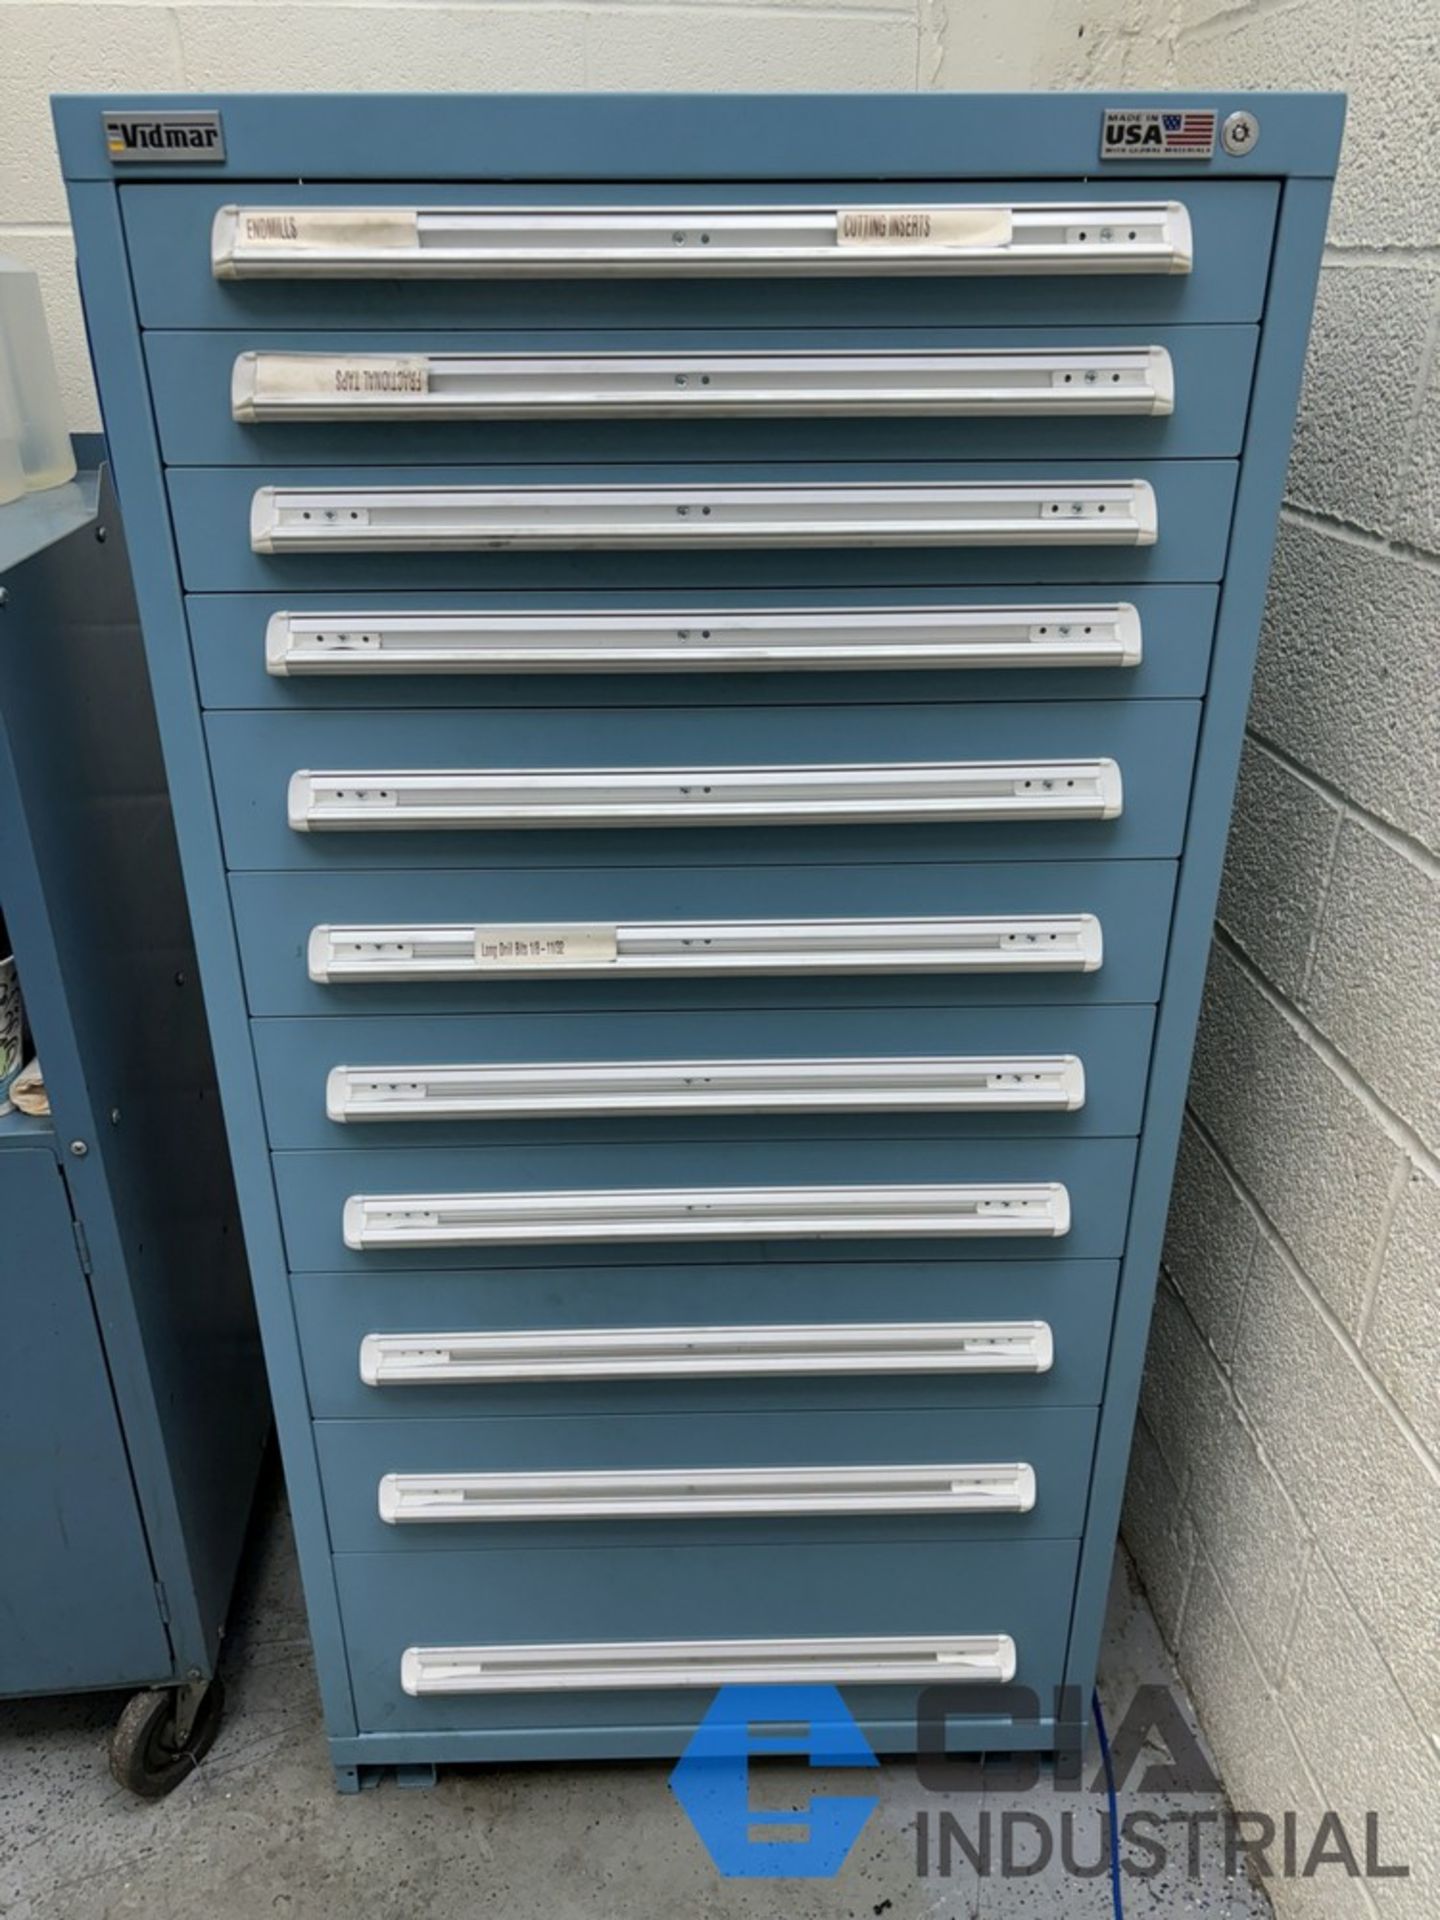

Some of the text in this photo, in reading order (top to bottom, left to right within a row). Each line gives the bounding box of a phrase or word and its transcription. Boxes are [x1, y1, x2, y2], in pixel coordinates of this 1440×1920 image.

[1108, 113, 1159, 122] MADE IN
[121, 123, 218, 148] Vidmar
[1106, 124, 1162, 145] USA
[246, 217, 298, 240] ENDMILLS
[843, 214, 930, 238] CUTTING INSERTS
[335, 369, 422, 392] FRACTIONAL TAPS
